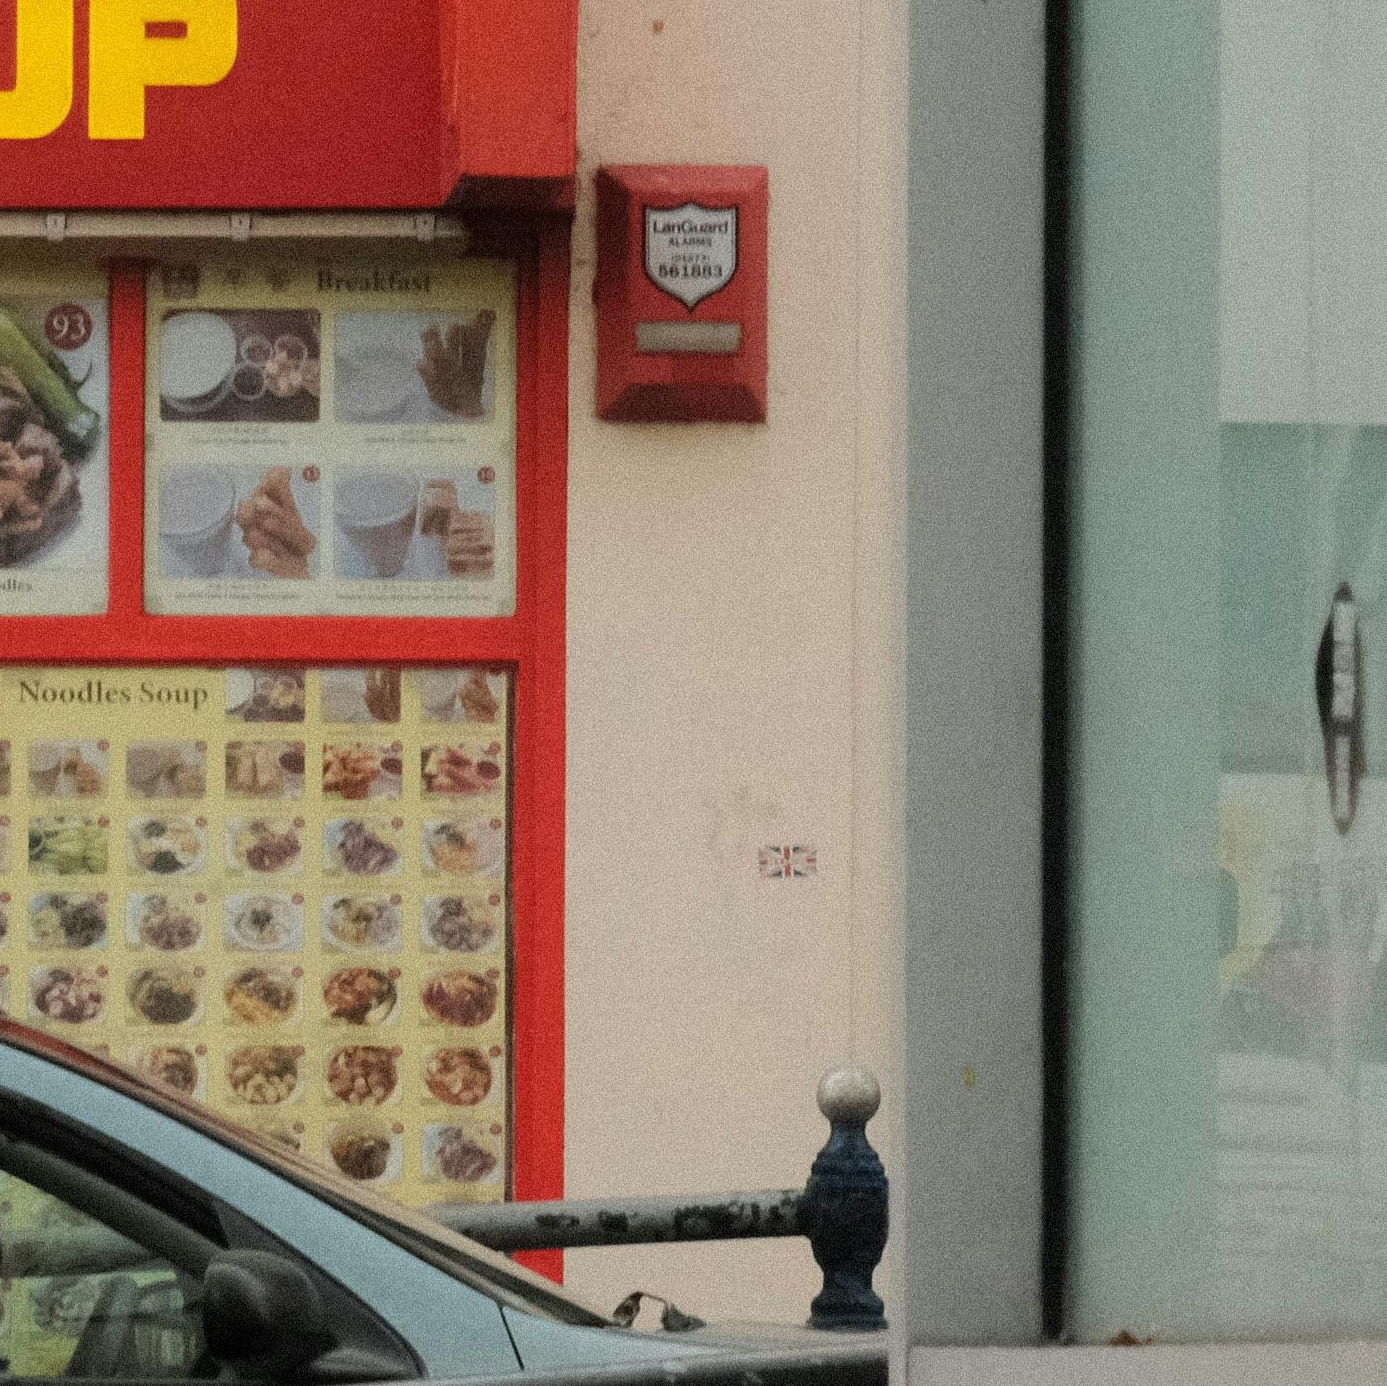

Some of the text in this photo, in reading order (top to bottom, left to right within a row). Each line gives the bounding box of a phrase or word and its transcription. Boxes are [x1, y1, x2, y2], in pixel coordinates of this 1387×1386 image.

[652, 219, 729, 234] LanGuard
[316, 269, 432, 294] Breakfast
[52, 312, 88, 341] 93
[18, 678, 210, 711] Noodles Soup
